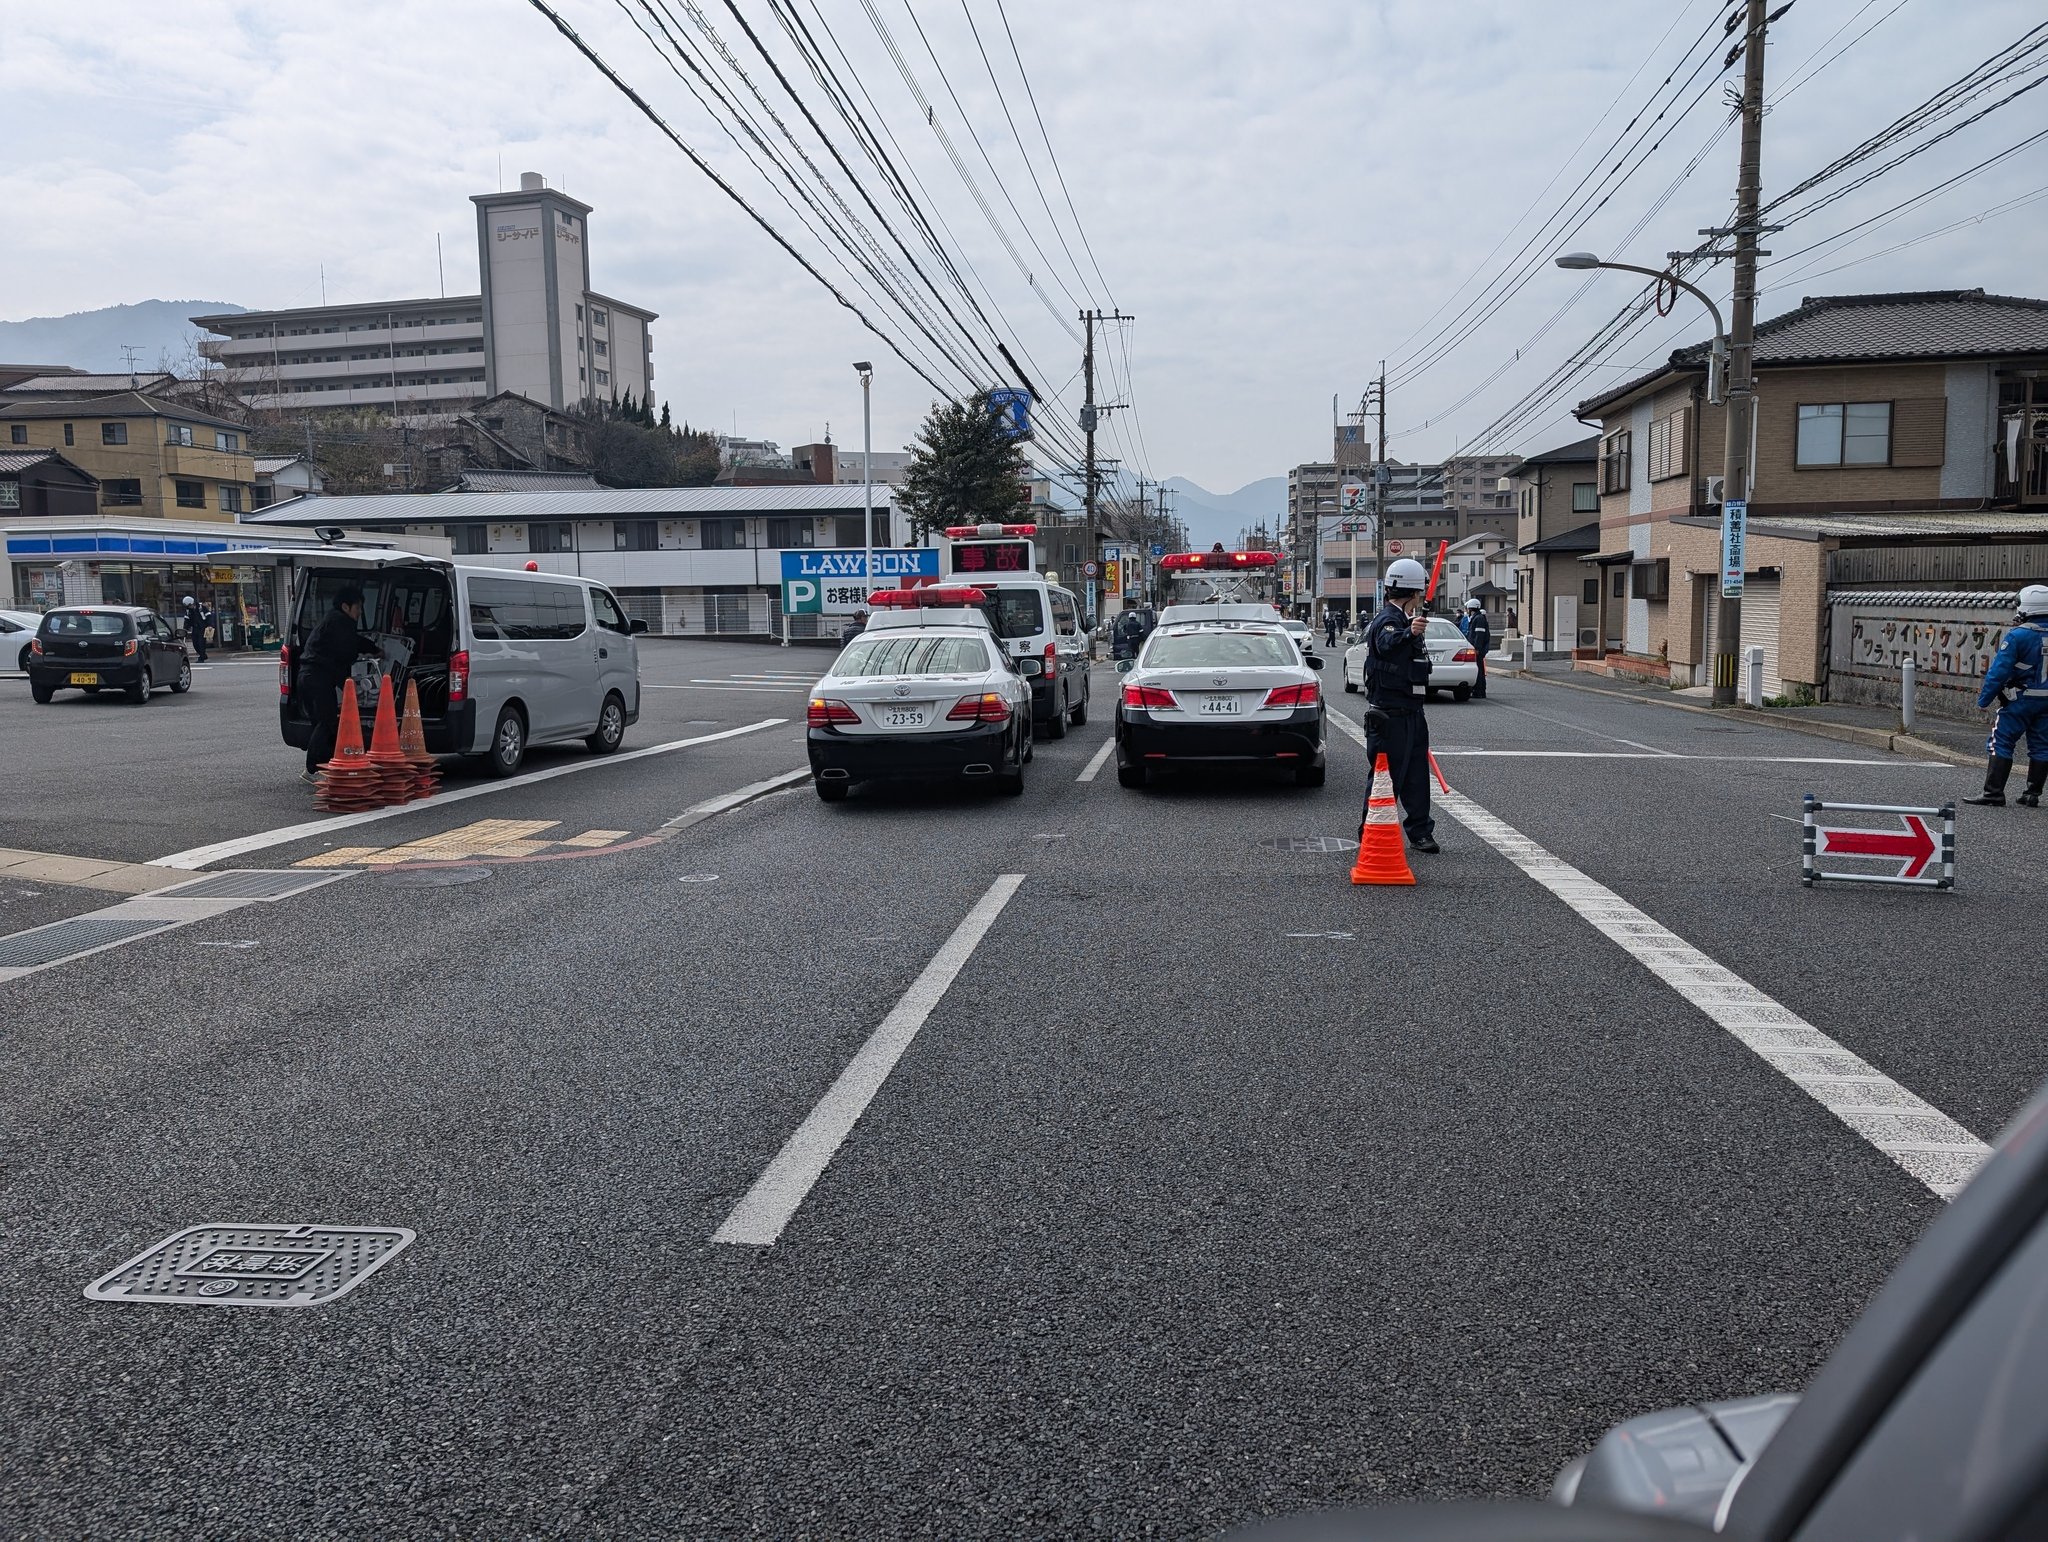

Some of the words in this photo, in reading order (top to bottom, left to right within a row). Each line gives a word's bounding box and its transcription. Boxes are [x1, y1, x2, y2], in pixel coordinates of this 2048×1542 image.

[800, 553, 921, 575] LAWSON
[960, 546, 1022, 571] 事故
[788, 580, 816, 612] P
[1208, 702, 1238, 712] 44-41
[892, 713, 923, 725] 23-59
